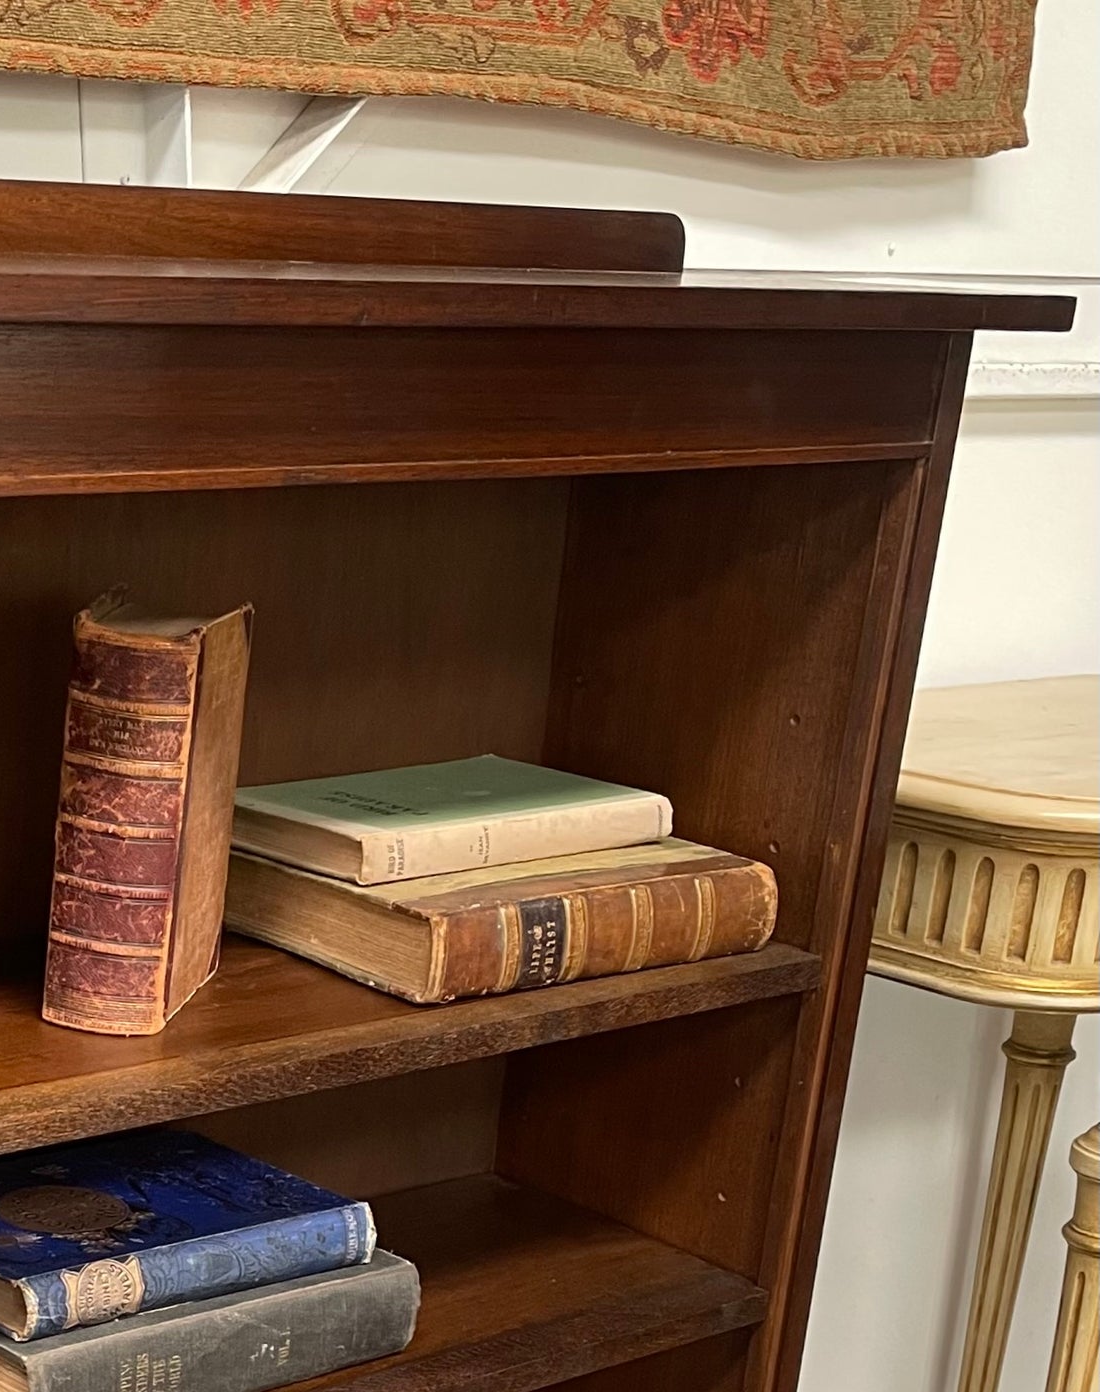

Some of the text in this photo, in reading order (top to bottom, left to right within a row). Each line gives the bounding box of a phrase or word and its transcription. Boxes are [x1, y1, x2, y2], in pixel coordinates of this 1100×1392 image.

[396, 838, 405, 876] PARADISE
[530, 943, 542, 974] LIFE
[152, 1359, 166, 1386] THE
